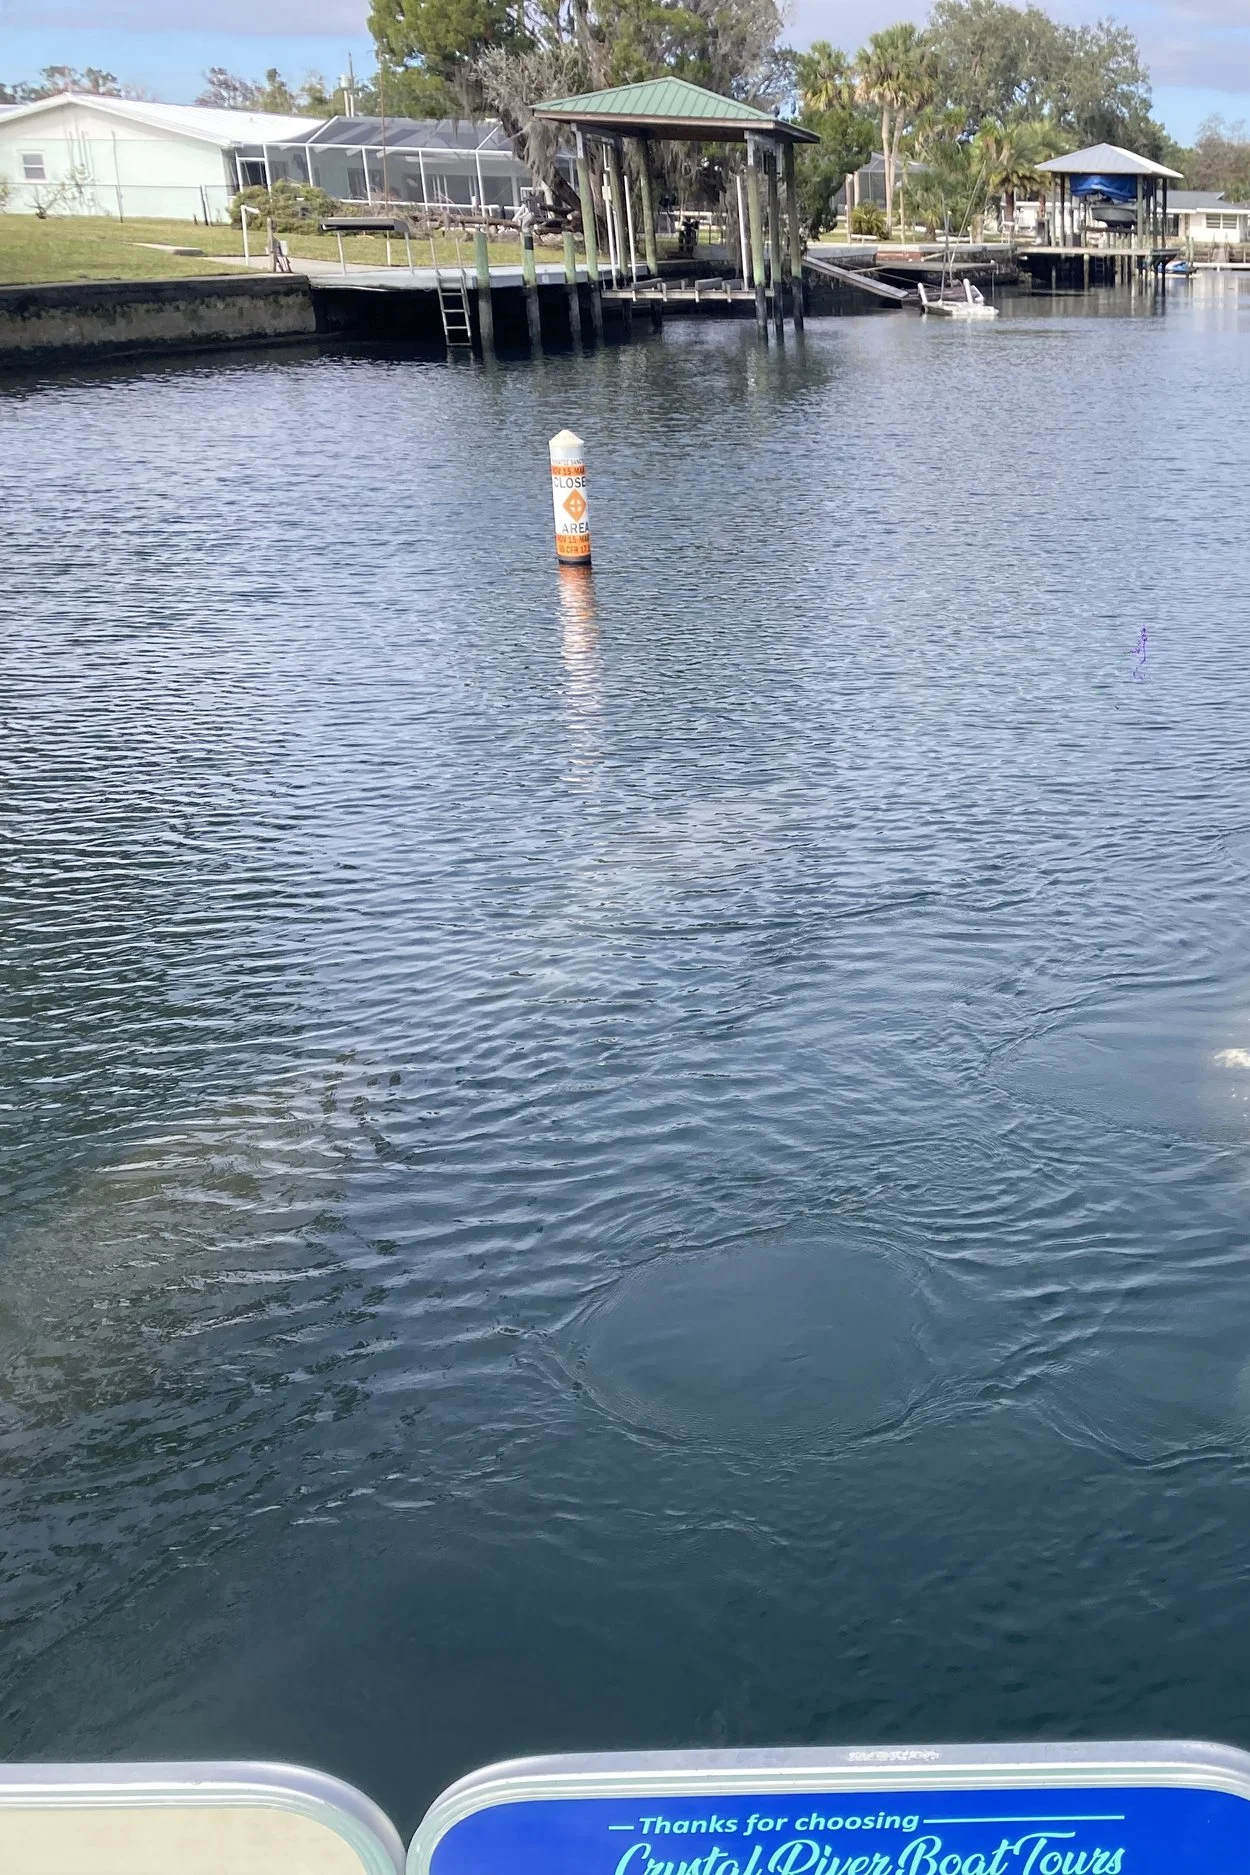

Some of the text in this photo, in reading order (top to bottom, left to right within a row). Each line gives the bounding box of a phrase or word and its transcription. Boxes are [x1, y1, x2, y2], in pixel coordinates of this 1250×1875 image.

[562, 522, 589, 534] AREA
[639, 1811, 919, 1836] Thanks for choosing
[615, 1831, 1126, 1875] Crystal River Boat Tours
